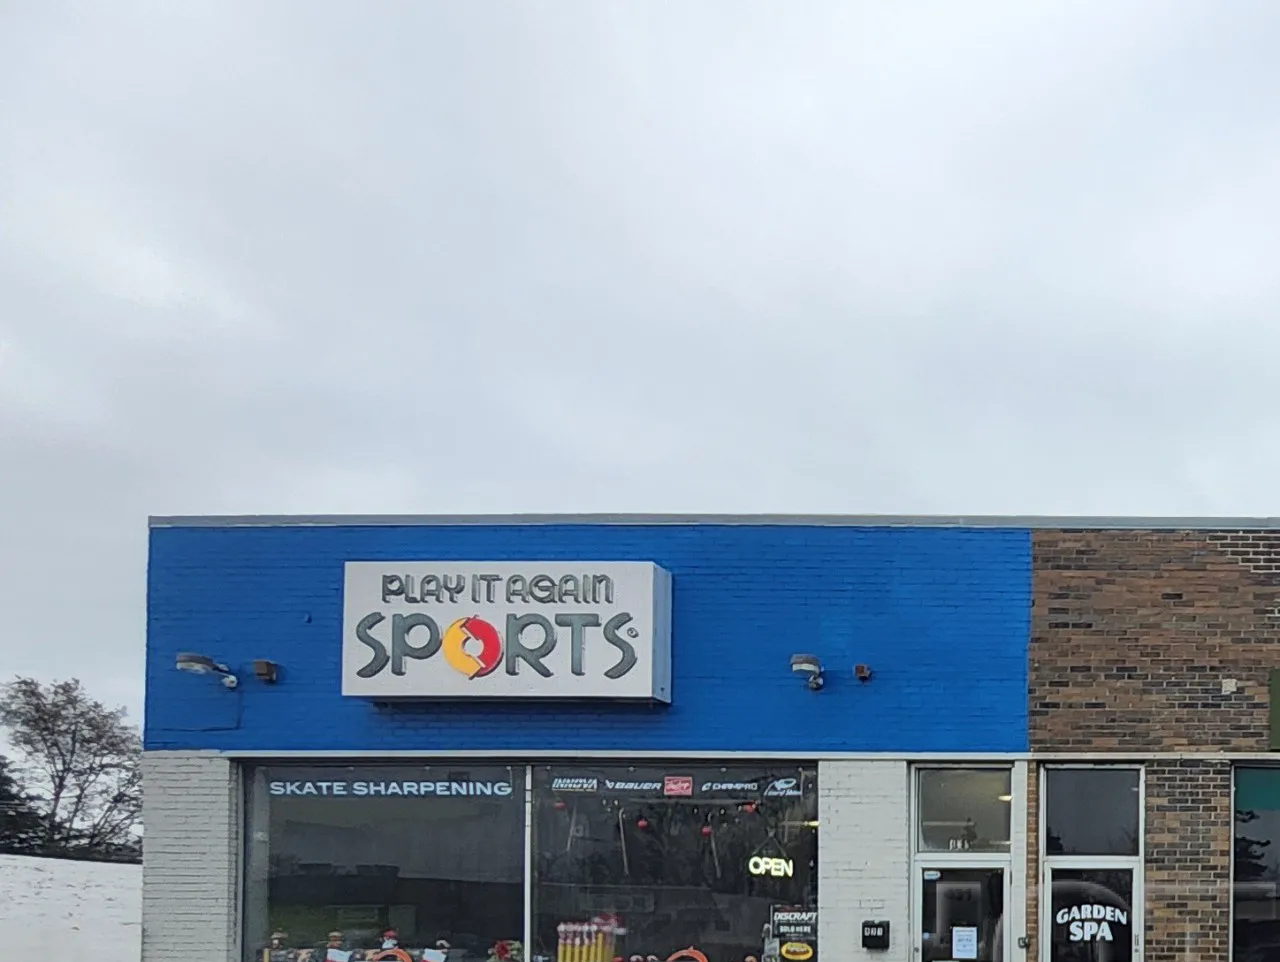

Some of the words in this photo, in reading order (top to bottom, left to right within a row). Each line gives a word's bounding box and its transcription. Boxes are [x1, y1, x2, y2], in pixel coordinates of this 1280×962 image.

[381, 574, 466, 604] PLAY
[471, 574, 502, 604] IT
[504, 574, 614, 604] AGAIN
[269, 780, 348, 796] SKATE
[352, 781, 514, 796] SHARPENING
[748, 856, 794, 877] OPEN
[1056, 904, 1128, 926] GARDEN
[1069, 921, 1114, 942] SPA
